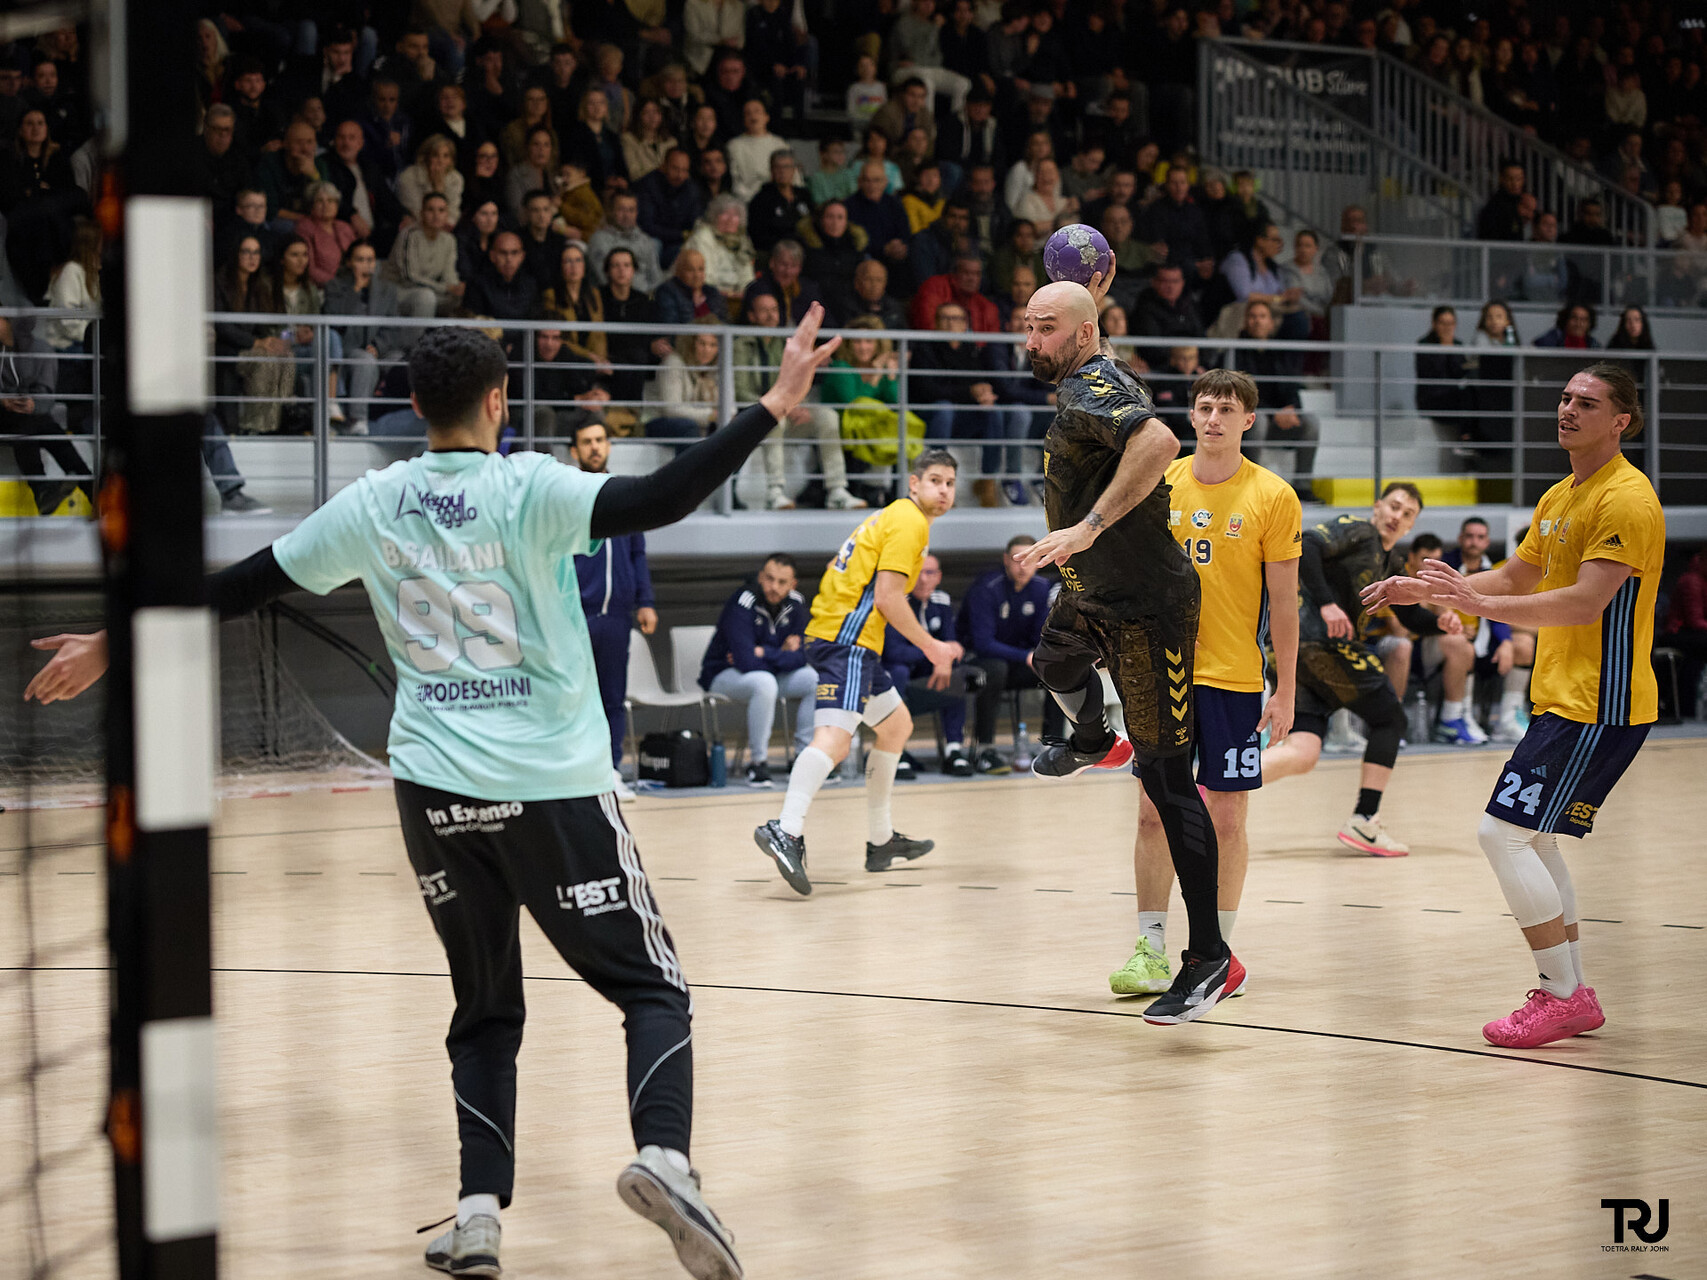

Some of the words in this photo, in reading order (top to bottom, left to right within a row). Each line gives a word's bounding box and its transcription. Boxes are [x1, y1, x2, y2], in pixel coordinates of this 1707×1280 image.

[1184, 538, 1213, 565] 19
[397, 577, 525, 674] 99
[424, 677, 532, 703] RODESCHINI
[1223, 747, 1260, 778] 19
[1496, 771, 1544, 816] 24
[425, 808, 449, 826] In
[556, 876, 621, 910] L'EST
